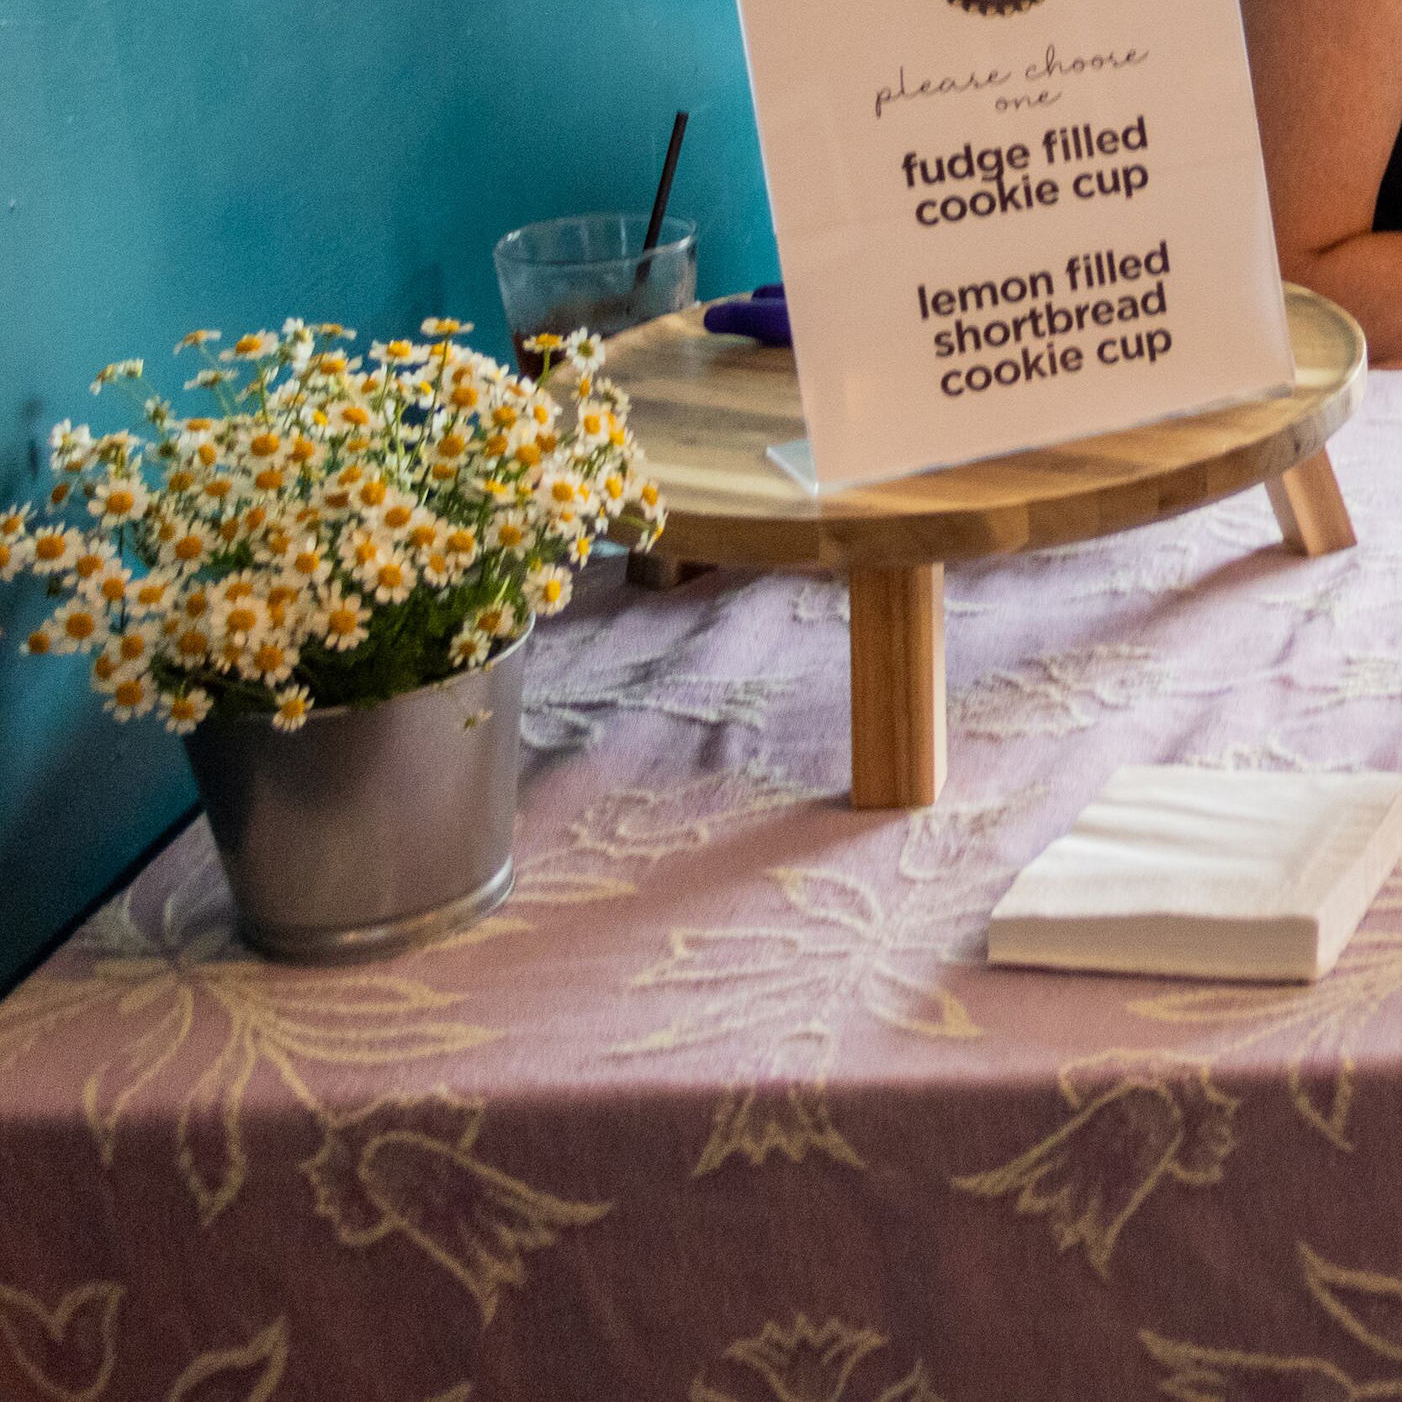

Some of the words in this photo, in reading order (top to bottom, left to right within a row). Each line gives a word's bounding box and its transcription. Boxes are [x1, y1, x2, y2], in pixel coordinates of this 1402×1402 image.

[875, 64, 1012, 119] please
[1024, 43, 1149, 81] choose
[994, 89, 1064, 114] one
[902, 142, 1031, 189] fudge
[1042, 114, 1149, 164] filled
[915, 173, 1060, 227] cookie
[1072, 162, 1149, 200] cup
[917, 269, 1055, 323] lemon
[1065, 239, 1171, 291] filled
[934, 280, 1168, 359] shortbread
[940, 341, 1084, 398] cookie
[1096, 327, 1173, 365] cup
